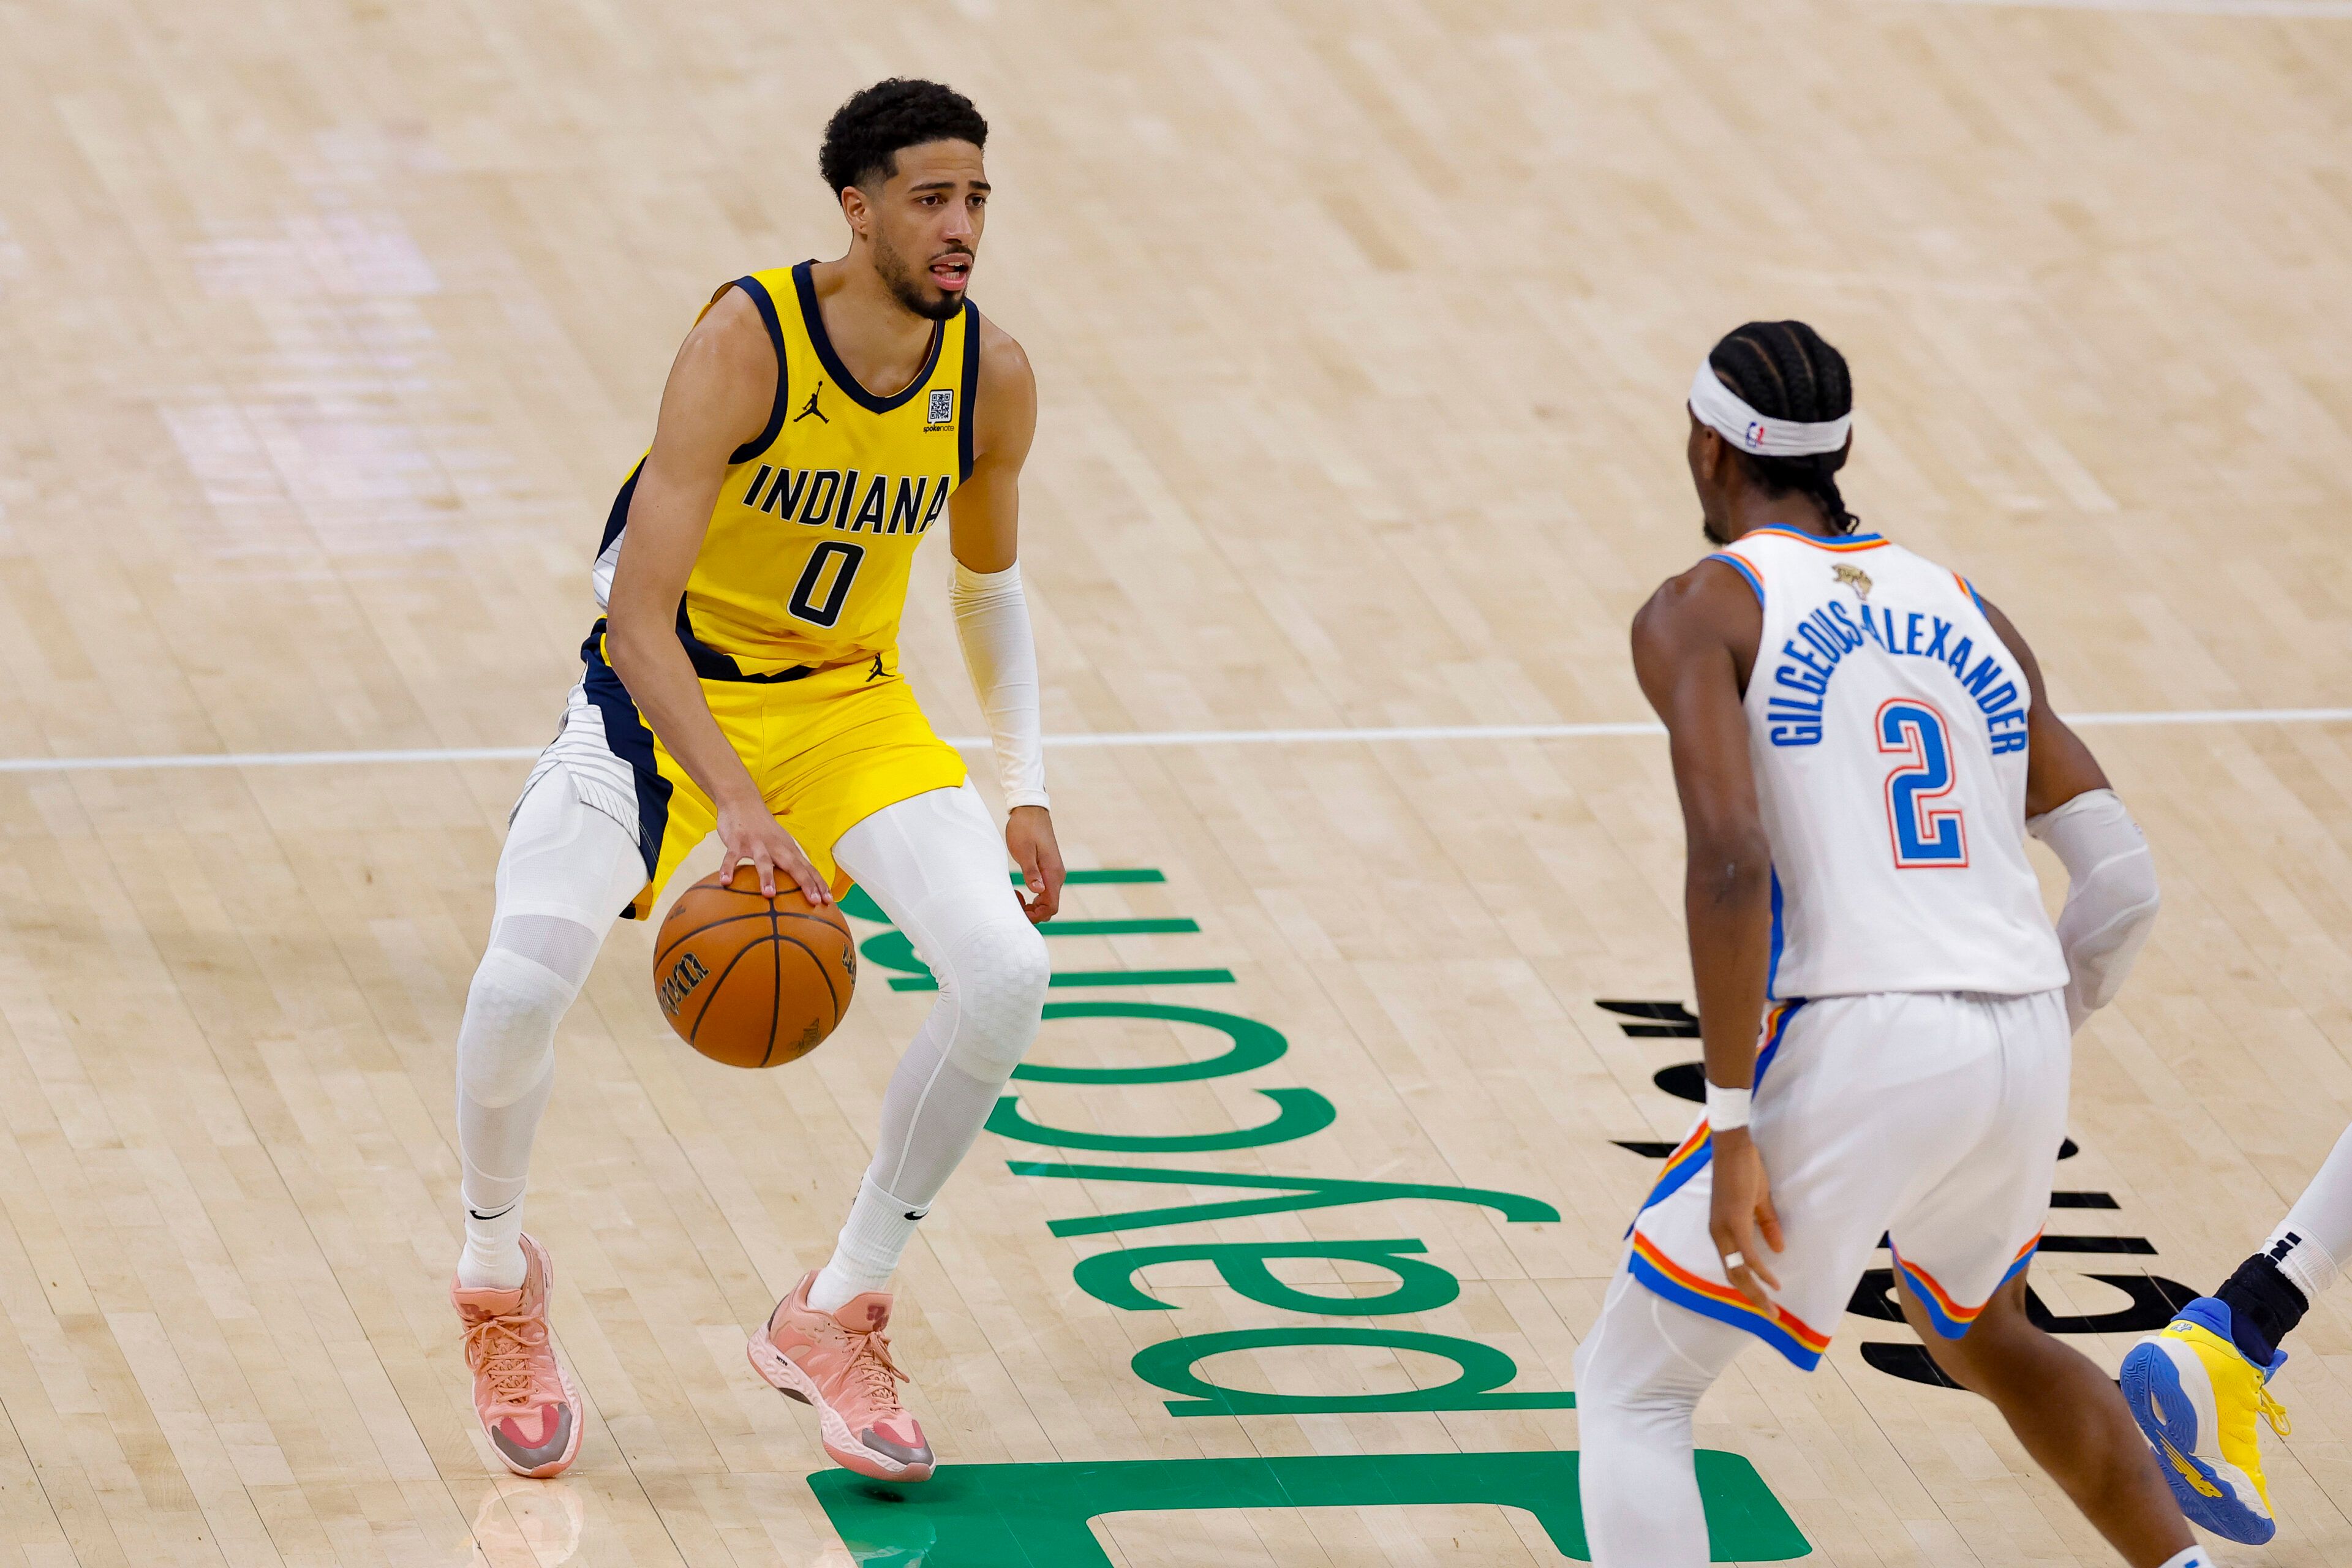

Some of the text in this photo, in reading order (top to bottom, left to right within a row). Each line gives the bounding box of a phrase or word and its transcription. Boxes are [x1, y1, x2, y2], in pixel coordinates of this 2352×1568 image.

[923, 424, 955, 434] spokenote
[741, 462, 951, 536] INDIANA
[786, 540, 867, 630] 0
[1875, 697, 1969, 869] 2
